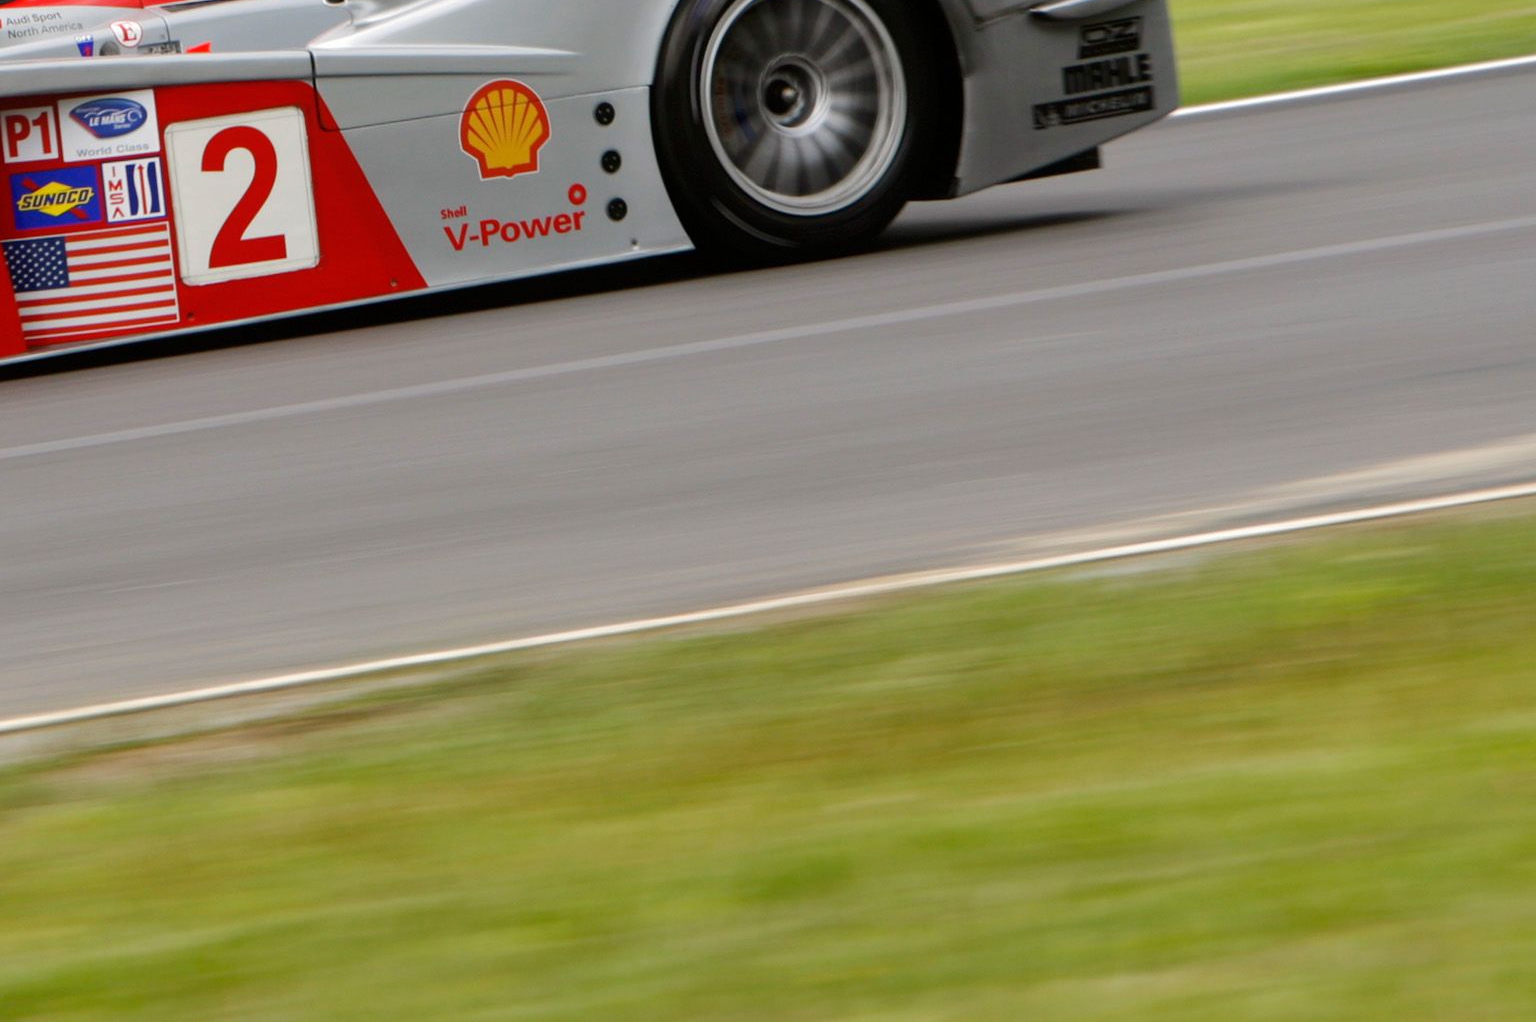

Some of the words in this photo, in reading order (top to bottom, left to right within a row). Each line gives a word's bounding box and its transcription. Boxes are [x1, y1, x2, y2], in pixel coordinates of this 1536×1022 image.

[5, 14, 31, 26] Audi
[32, 11, 62, 23] Sport
[7, 25, 41, 39] North
[41, 22, 83, 35] America
[89, 117, 101, 127] LE
[101, 113, 126, 126] MANS
[5, 111, 52, 158] P1
[76, 146, 112, 158] World
[116, 143, 150, 154] Class
[20, 189, 90, 210] SUNOCO
[200, 125, 288, 269] 2
[440, 205, 467, 220] Shell
[443, 210, 586, 251] V-Power
